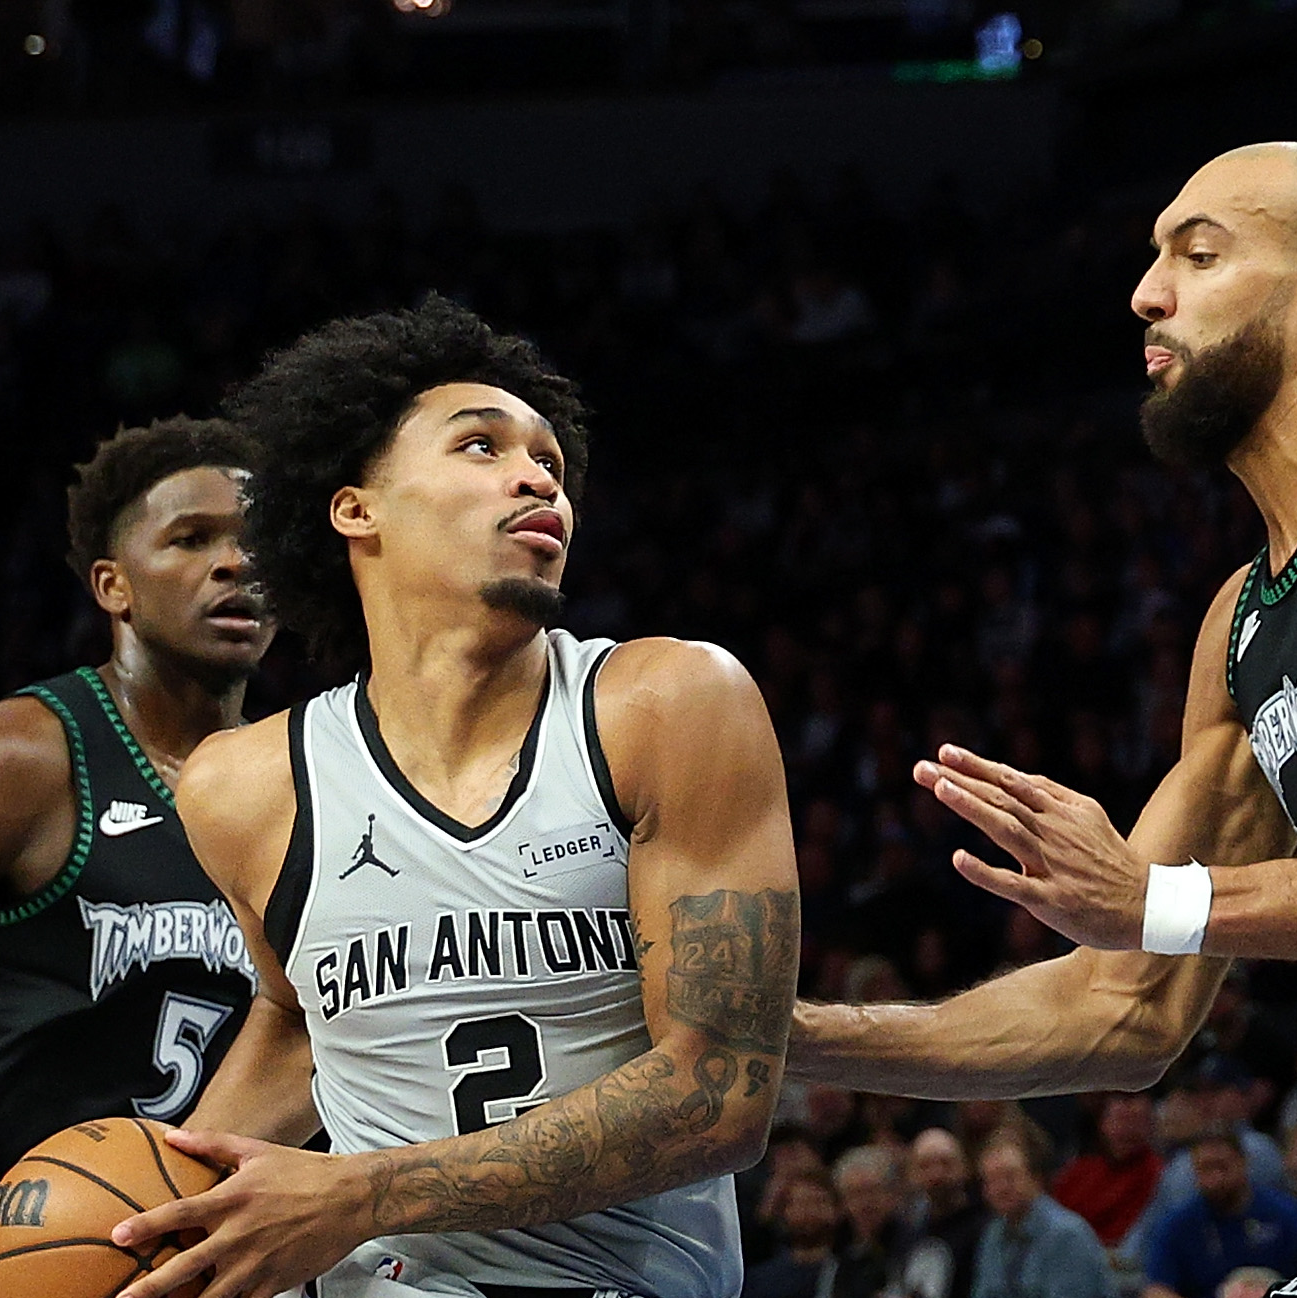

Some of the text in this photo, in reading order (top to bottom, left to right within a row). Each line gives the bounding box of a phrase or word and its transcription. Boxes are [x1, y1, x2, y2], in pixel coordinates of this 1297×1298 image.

[109, 800, 148, 822] NIKE
[531, 835, 602, 866] LEDGER
[315, 922, 412, 1024] SAN
[131, 990, 234, 1120] 5
[440, 1010, 551, 1137] 2
